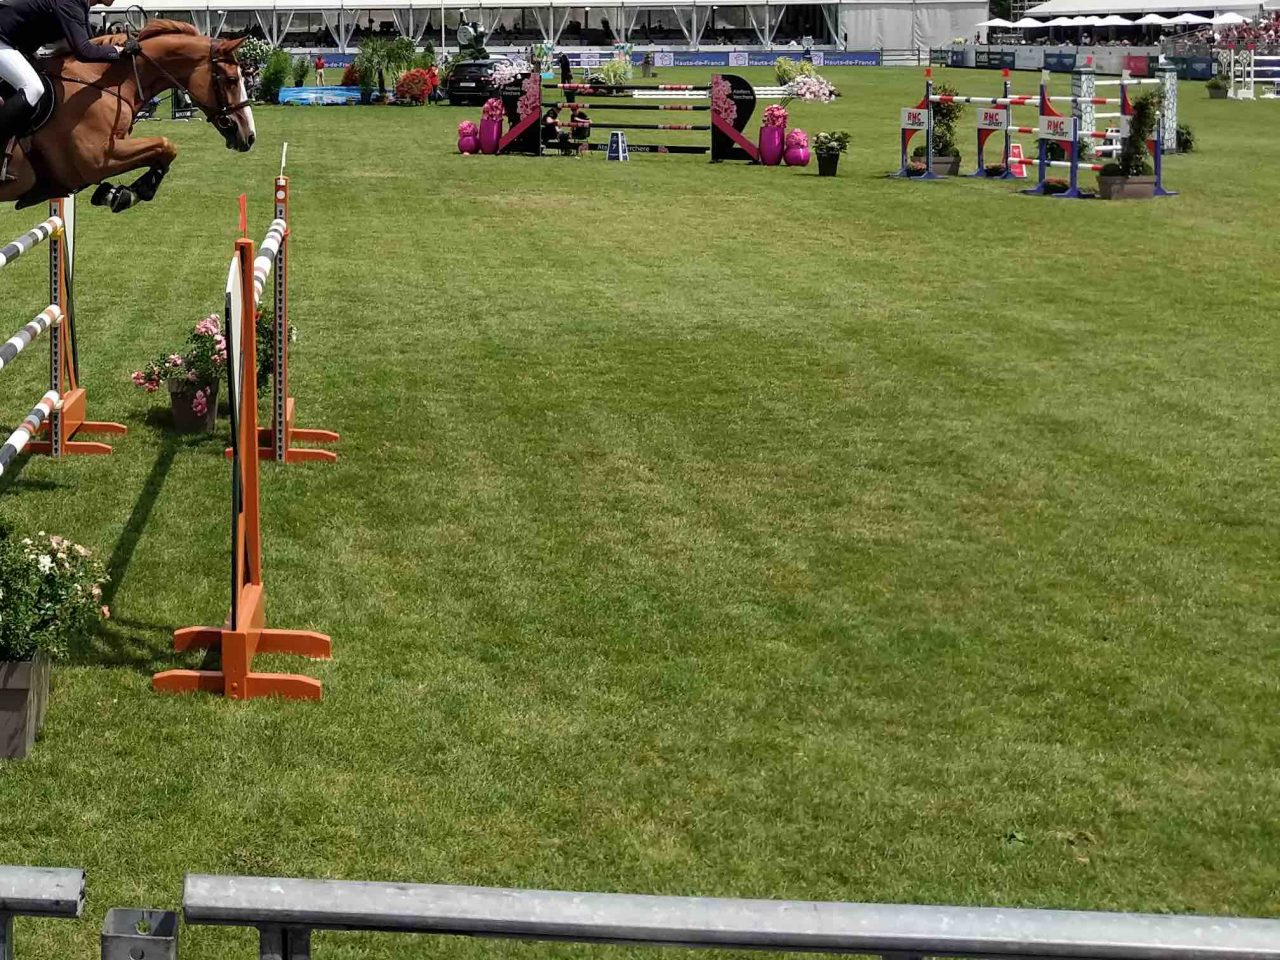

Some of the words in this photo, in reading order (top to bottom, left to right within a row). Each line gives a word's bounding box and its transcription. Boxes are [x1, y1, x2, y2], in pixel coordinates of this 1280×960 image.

[907, 112, 922, 121] RMC
[984, 112, 999, 121] RMC
[1047, 120, 1064, 130] RMC
